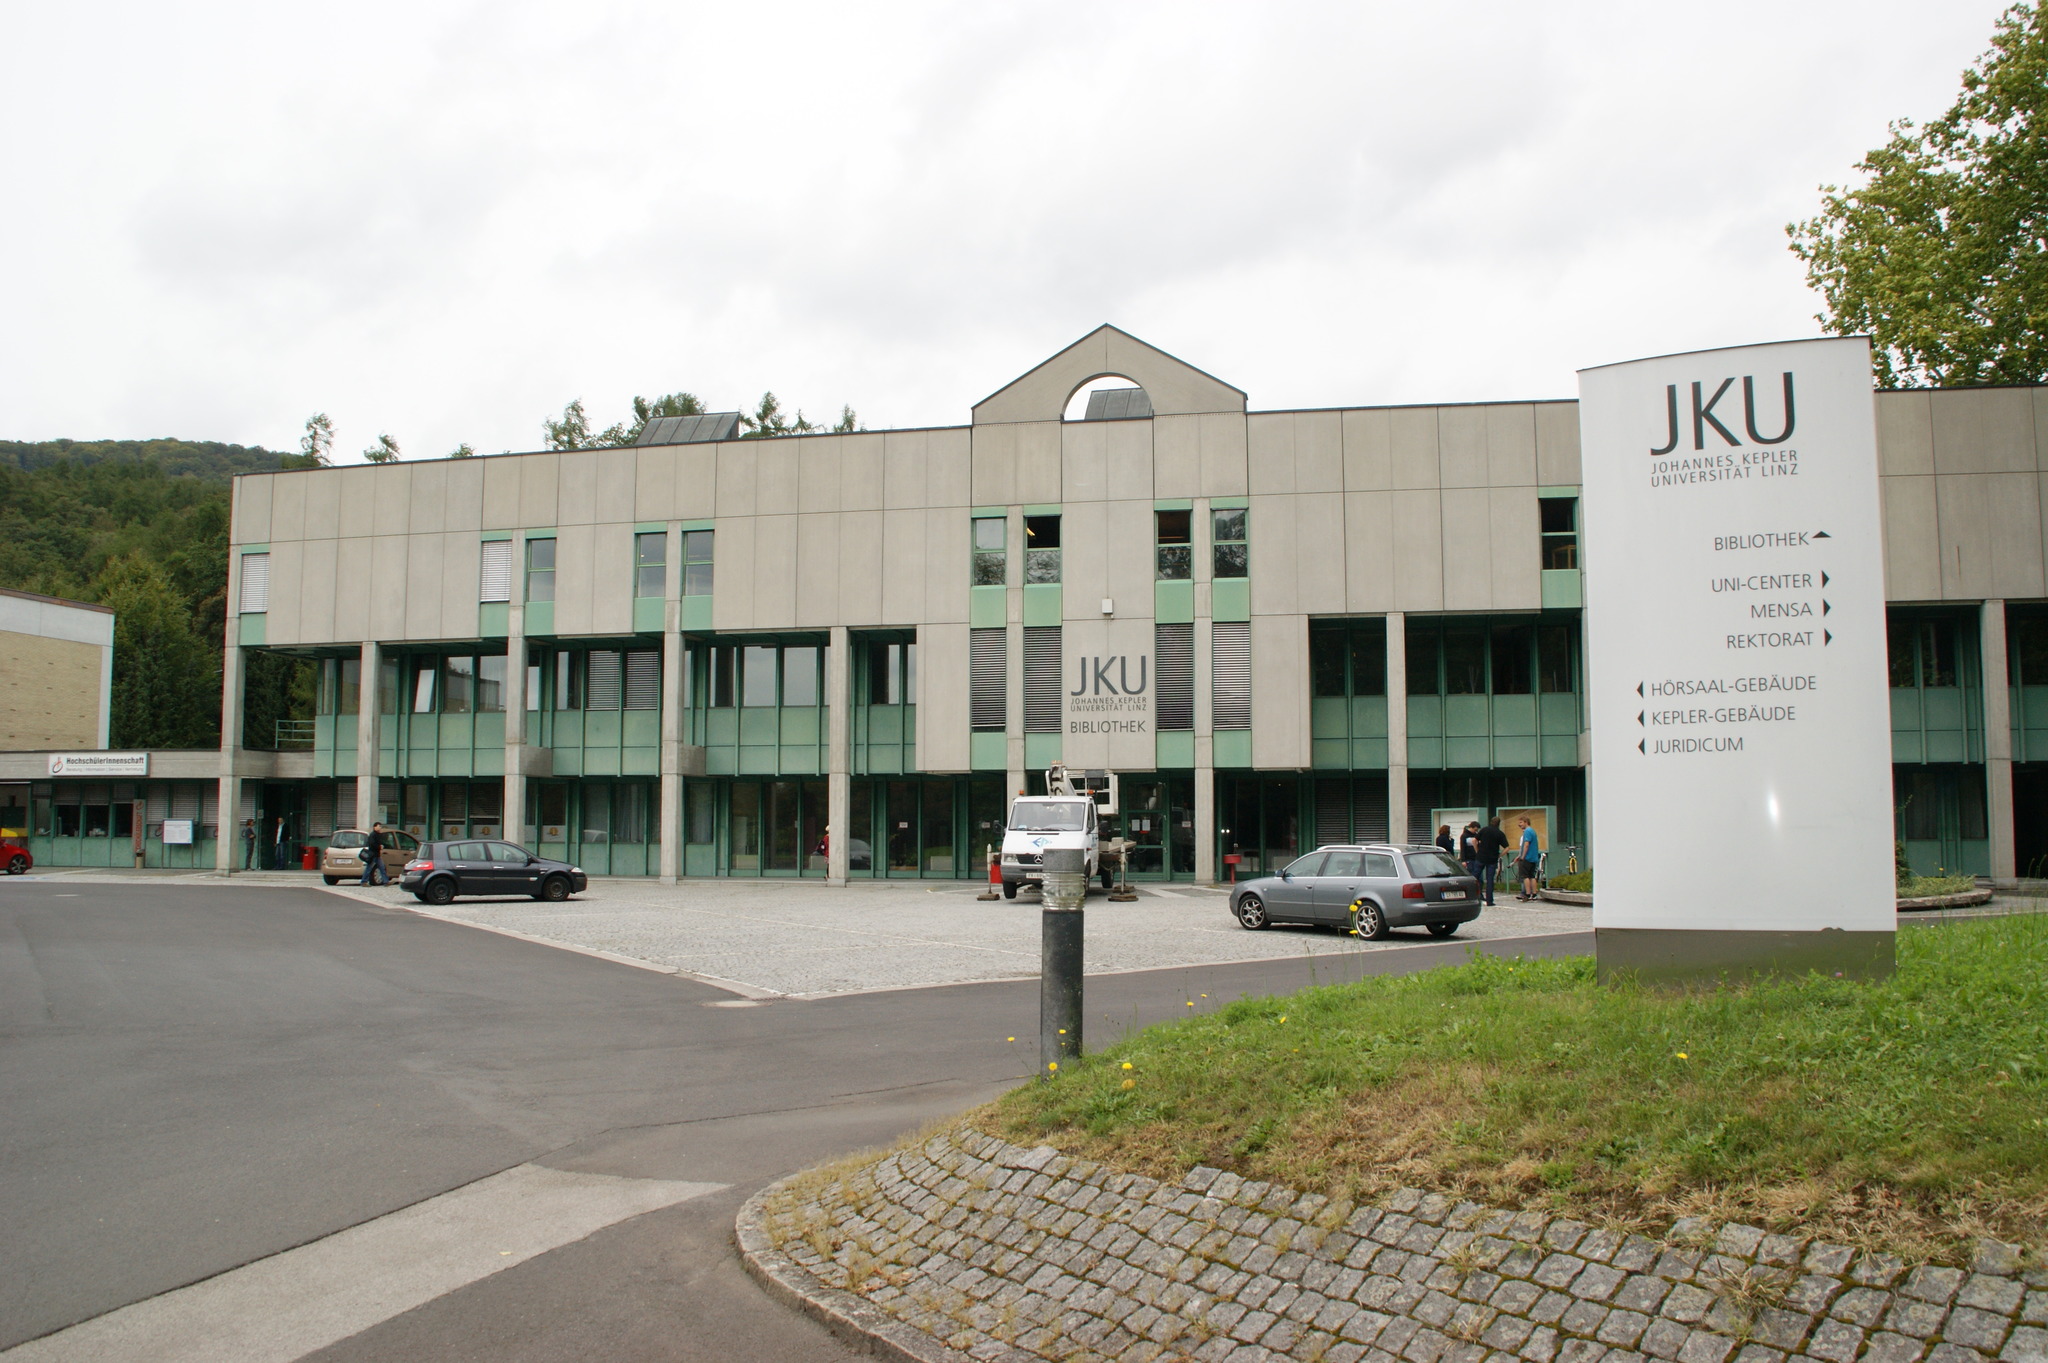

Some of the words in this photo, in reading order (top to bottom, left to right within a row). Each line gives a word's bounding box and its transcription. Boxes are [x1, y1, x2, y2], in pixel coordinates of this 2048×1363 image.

[1650, 372, 1795, 455] JKU
[1651, 455, 1734, 475] JOHANNES
[1743, 449, 1798, 466] KEPLER
[1651, 464, 1751, 488] UNIVERSITÄT
[1761, 463, 1799, 477] LINZ
[1714, 531, 1810, 551] BIBLIOTHEK
[1711, 573, 1812, 593] UNI-CENTER
[1750, 602, 1813, 619] MENSA
[1727, 631, 1814, 649] REKTORAT
[1071, 656, 1146, 696] JKU
[1651, 674, 1817, 697] HÖRSAAL-GEBÄUDE
[1070, 703, 1123, 711] UNIVERSITÄT
[1071, 697, 1115, 705] JOHANNES
[1652, 704, 1796, 726] KEPLER-GEBÄUDE
[1070, 720, 1146, 733] BIBLIOTHEK
[1653, 737, 1744, 754] JURIDICUM
